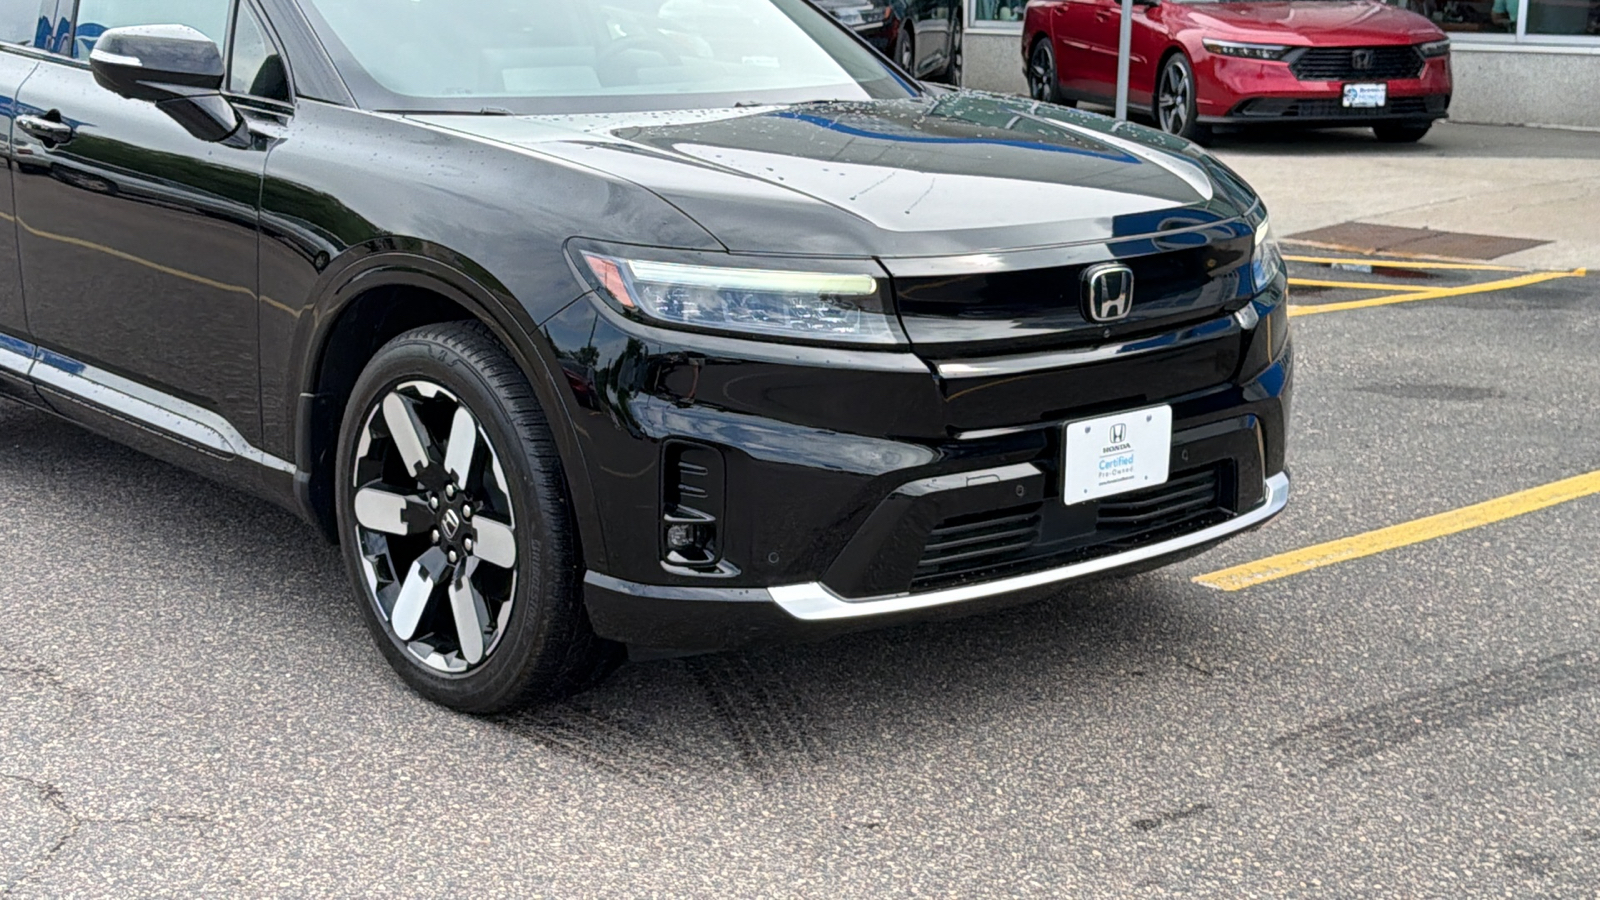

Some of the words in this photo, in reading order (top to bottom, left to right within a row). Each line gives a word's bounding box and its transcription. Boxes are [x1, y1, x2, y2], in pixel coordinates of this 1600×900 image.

[1103, 443, 1131, 453] HONDA
[1099, 454, 1134, 470] Certified
[1098, 466, 1133, 478] Pre-Owned
